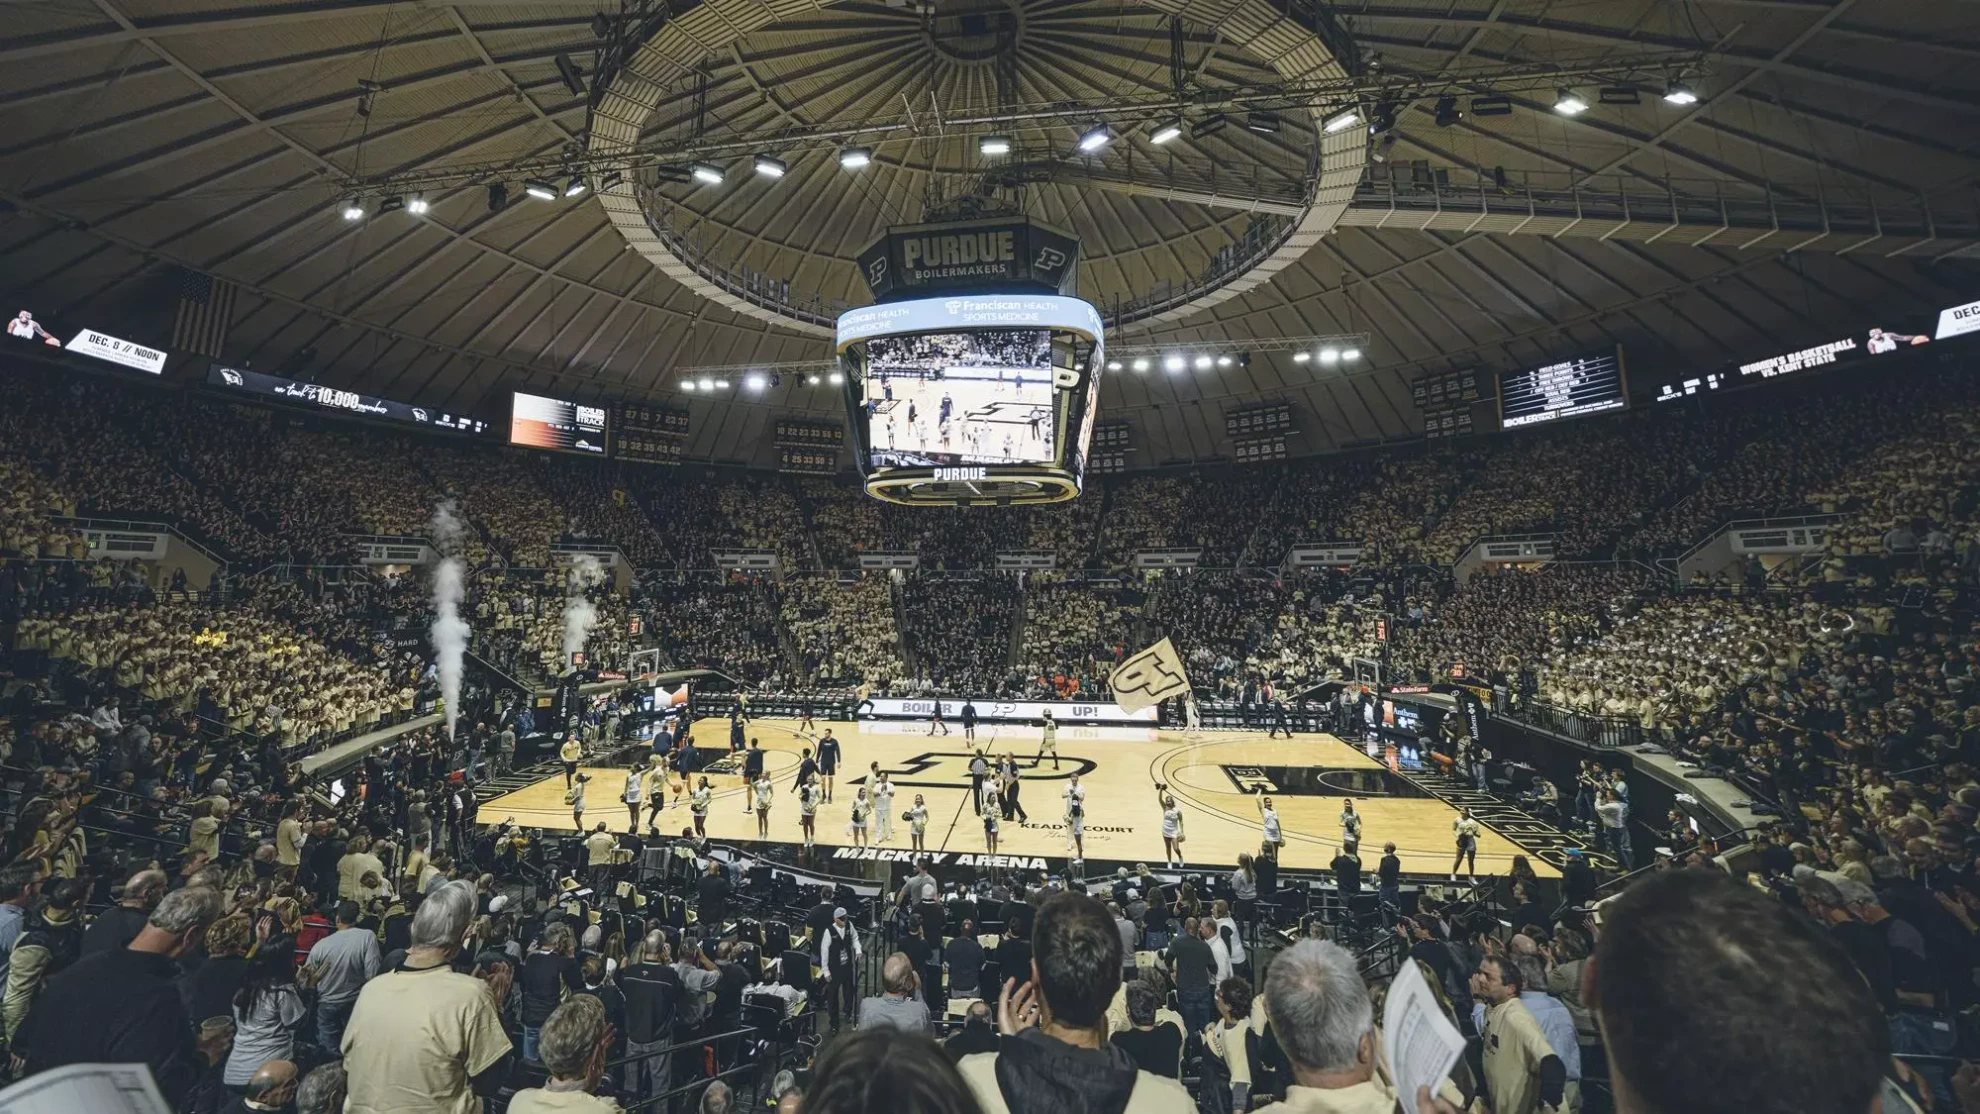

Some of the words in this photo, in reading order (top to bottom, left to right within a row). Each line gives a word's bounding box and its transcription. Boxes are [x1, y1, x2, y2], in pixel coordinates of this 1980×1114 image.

[904, 231, 1014, 268] PURDUE
[1034, 246, 1066, 270] P
[870, 256, 887, 287] P
[916, 264, 1006, 279] BOILERMAKERS
[964, 300, 1021, 310] Franciscan
[1024, 302, 1058, 310] HEALTH
[878, 309, 910, 319] HEALTH
[964, 312, 997, 321] SPORTS
[998, 312, 1039, 321] MEDICINE
[88, 334, 110, 348] DEC.
[134, 348, 160, 362] NOON
[1740, 356, 1786, 375] WOMEN'S
[1787, 338, 1856, 363] BASKETBALL
[1760, 366, 1778, 378] VS.
[1778, 361, 1802, 374] KENT
[1803, 353, 1836, 368] STATE
[317, 386, 360, 408] 10,000
[580, 416, 604, 426] TRACK
[1504, 414, 1539, 428] BOILER
[934, 467, 986, 480] PURDUE
[398, 639, 418, 647] HARD
[902, 702, 952, 714] BOILR
[1072, 706, 1099, 718] UP!
[1394, 706, 1418, 720] Anthem
[1467, 714, 1480, 741] Anthem
[1083, 825, 1134, 834] COURT
[954, 854, 1048, 870] ARENA
